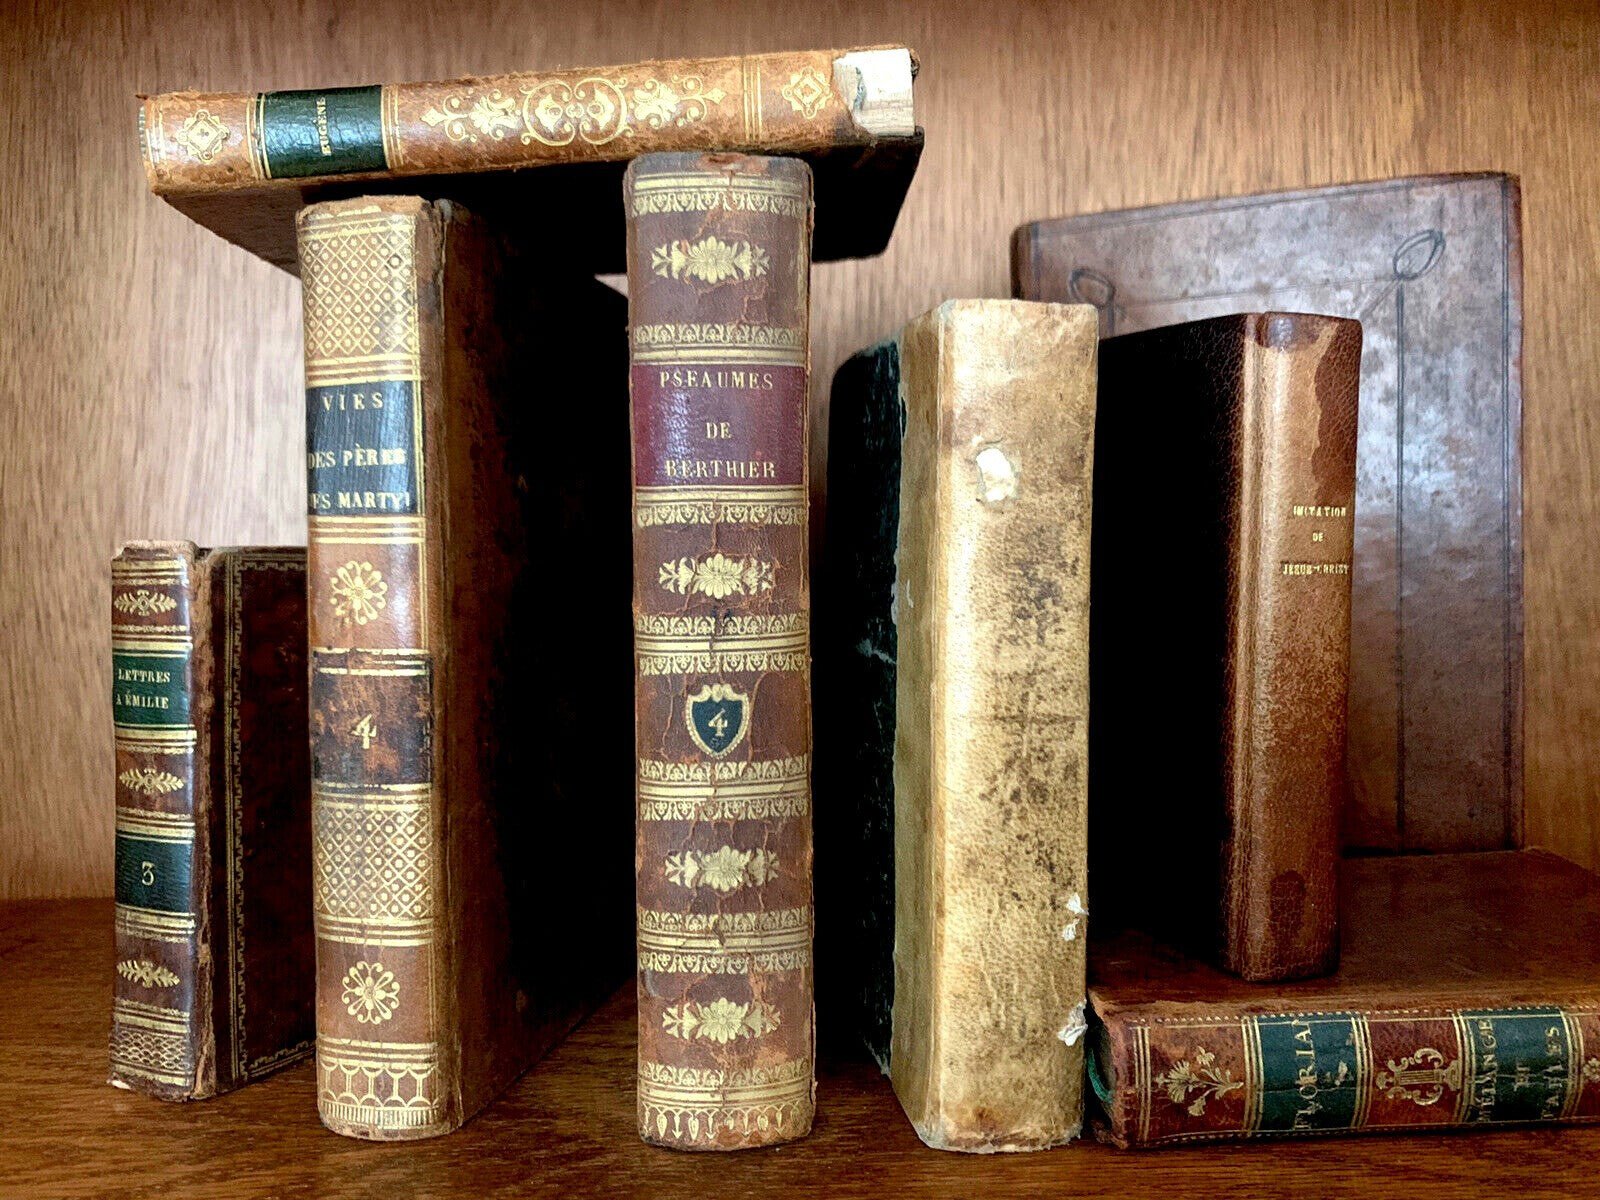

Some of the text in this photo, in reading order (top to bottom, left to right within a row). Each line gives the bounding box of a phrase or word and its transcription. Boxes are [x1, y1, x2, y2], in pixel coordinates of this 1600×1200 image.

[660, 370, 774, 390] PSEAUMES
[321, 392, 384, 411] VIES
[705, 422, 732, 439] DE
[307, 442, 408, 469] DES PÈRES
[665, 459, 778, 479] BERTHIER
[1293, 505, 1346, 517] IMITATION
[1312, 532, 1324, 542] DE
[118, 668, 171, 684] LETTRES
[351, 713, 377, 749] 4
[708, 708, 728, 737] 4
[142, 861, 155, 886] 3
